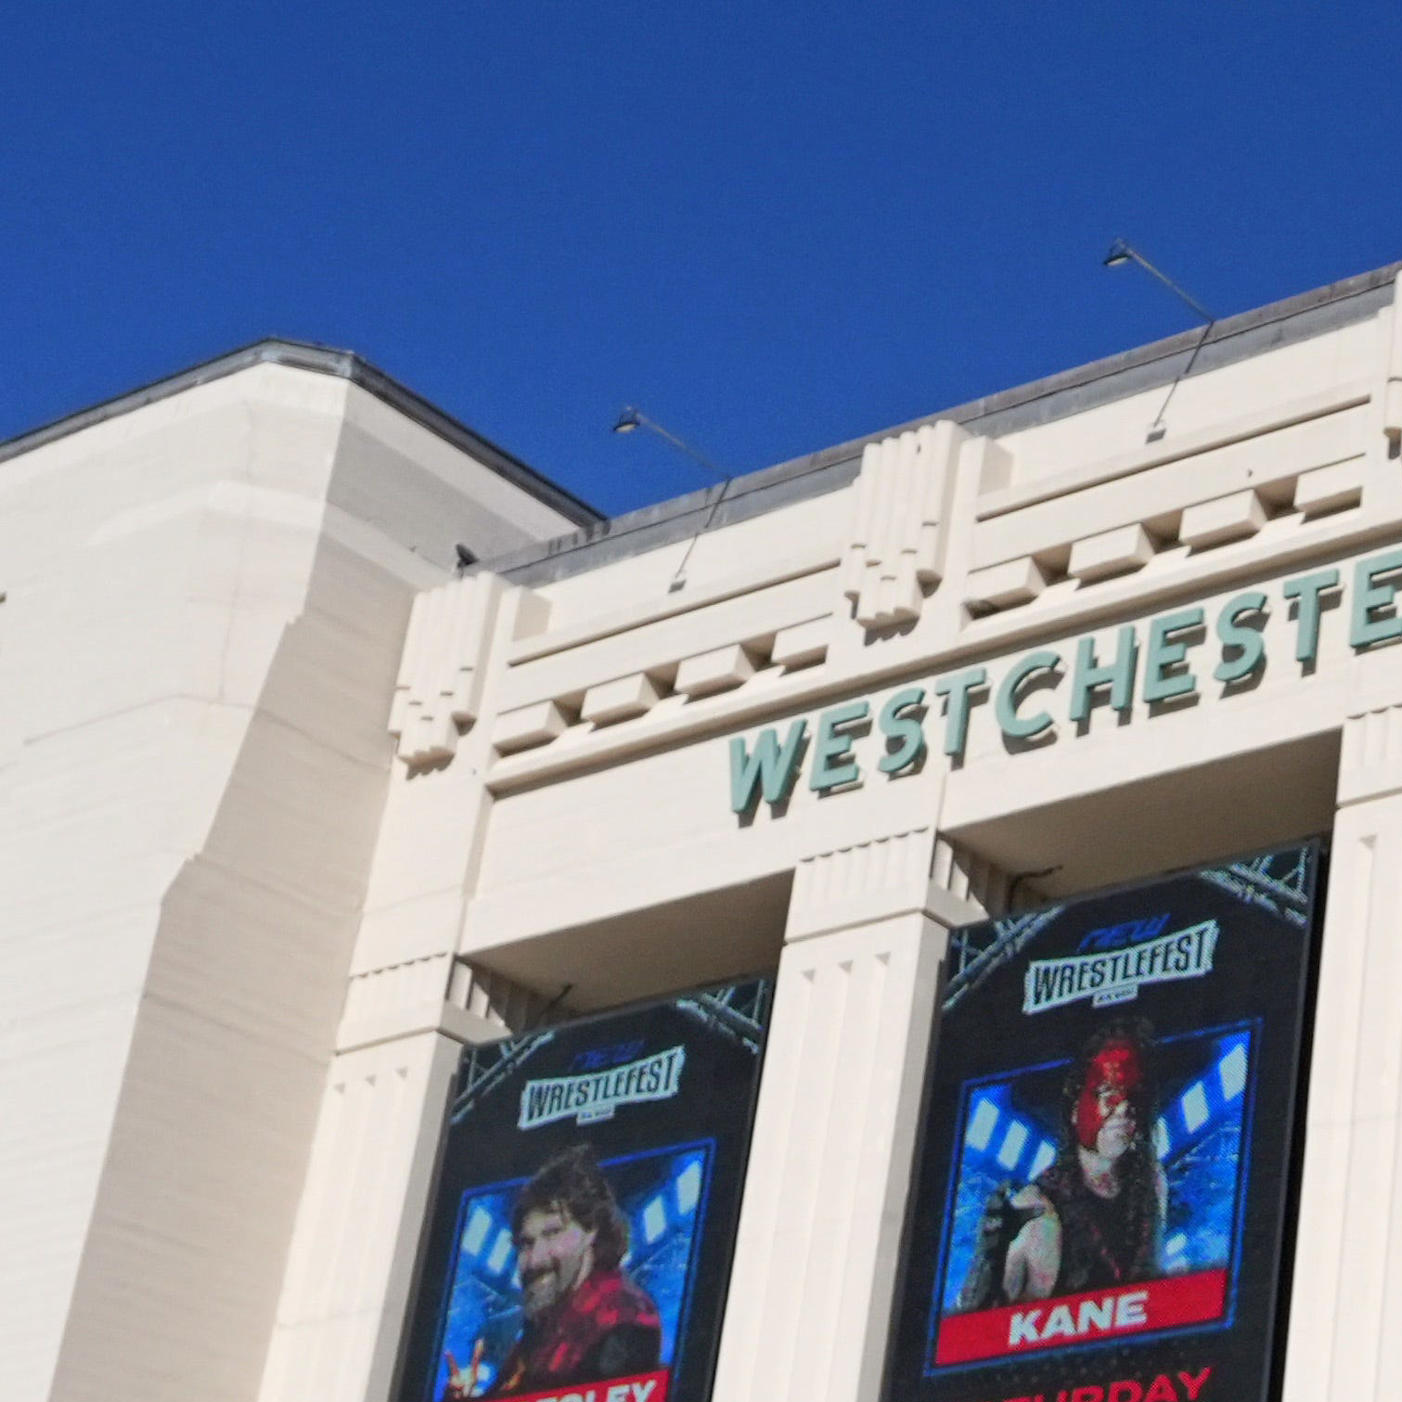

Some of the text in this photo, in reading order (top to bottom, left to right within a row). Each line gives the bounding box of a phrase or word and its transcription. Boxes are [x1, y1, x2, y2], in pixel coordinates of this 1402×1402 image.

[1034, 927, 1208, 1005] WRESTLEFEST
[527, 1054, 676, 1121] WRESTLEFEST
[1009, 1291, 1149, 1346] KANE
